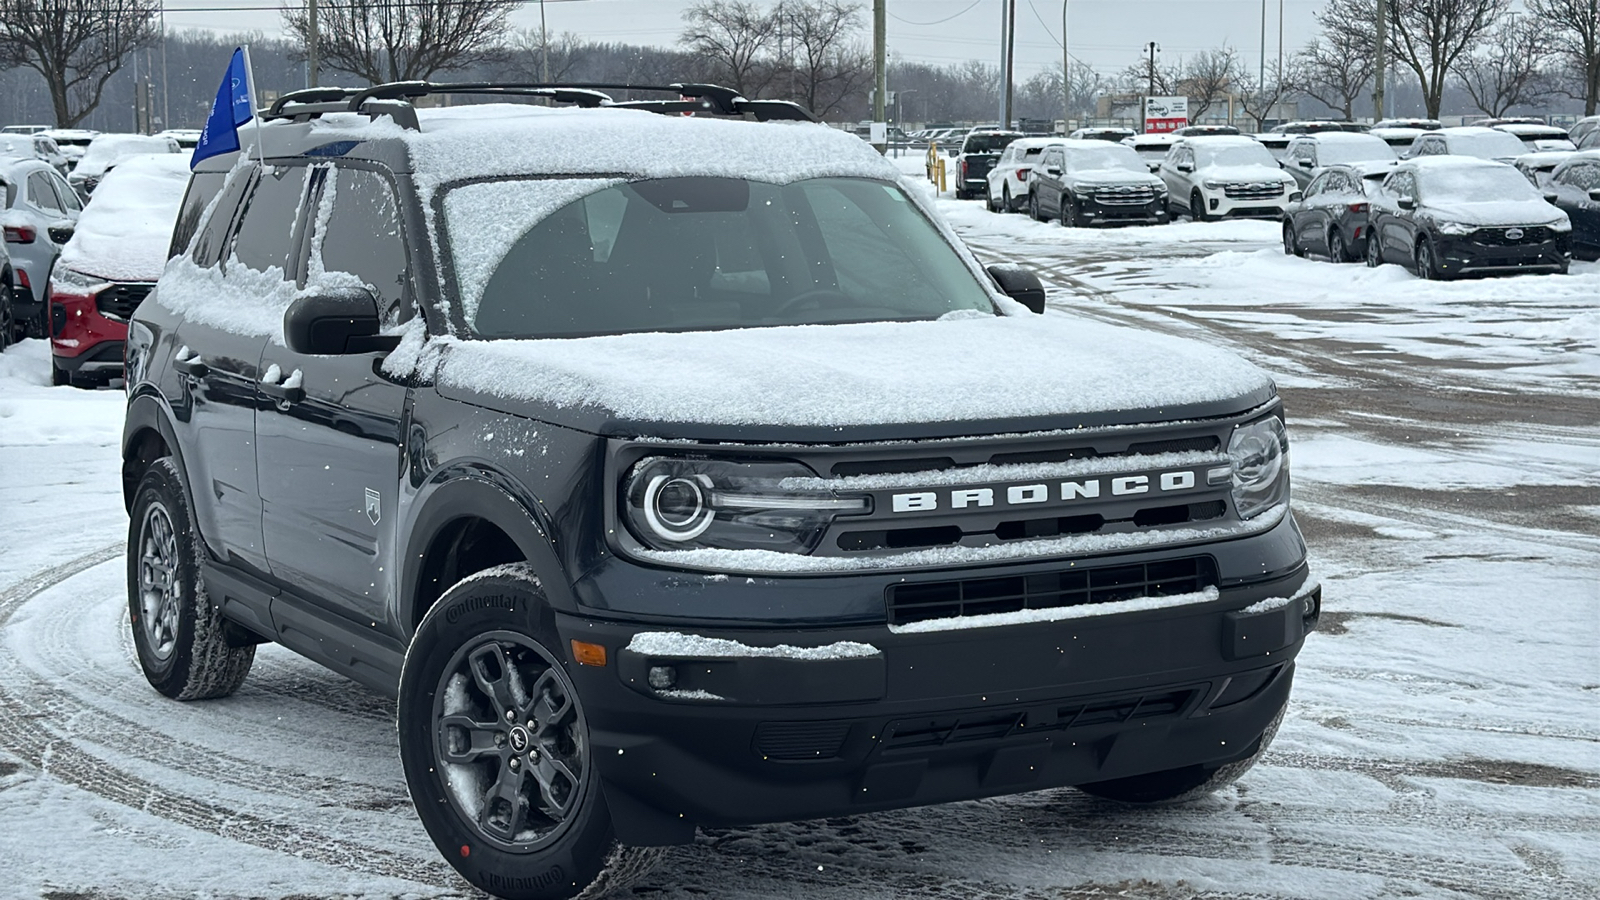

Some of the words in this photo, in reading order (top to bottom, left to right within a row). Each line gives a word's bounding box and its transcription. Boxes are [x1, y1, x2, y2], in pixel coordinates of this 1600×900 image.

[892, 471, 1195, 513] BRONCO
[446, 594, 517, 625] Continental
[489, 865, 565, 891] Continental
